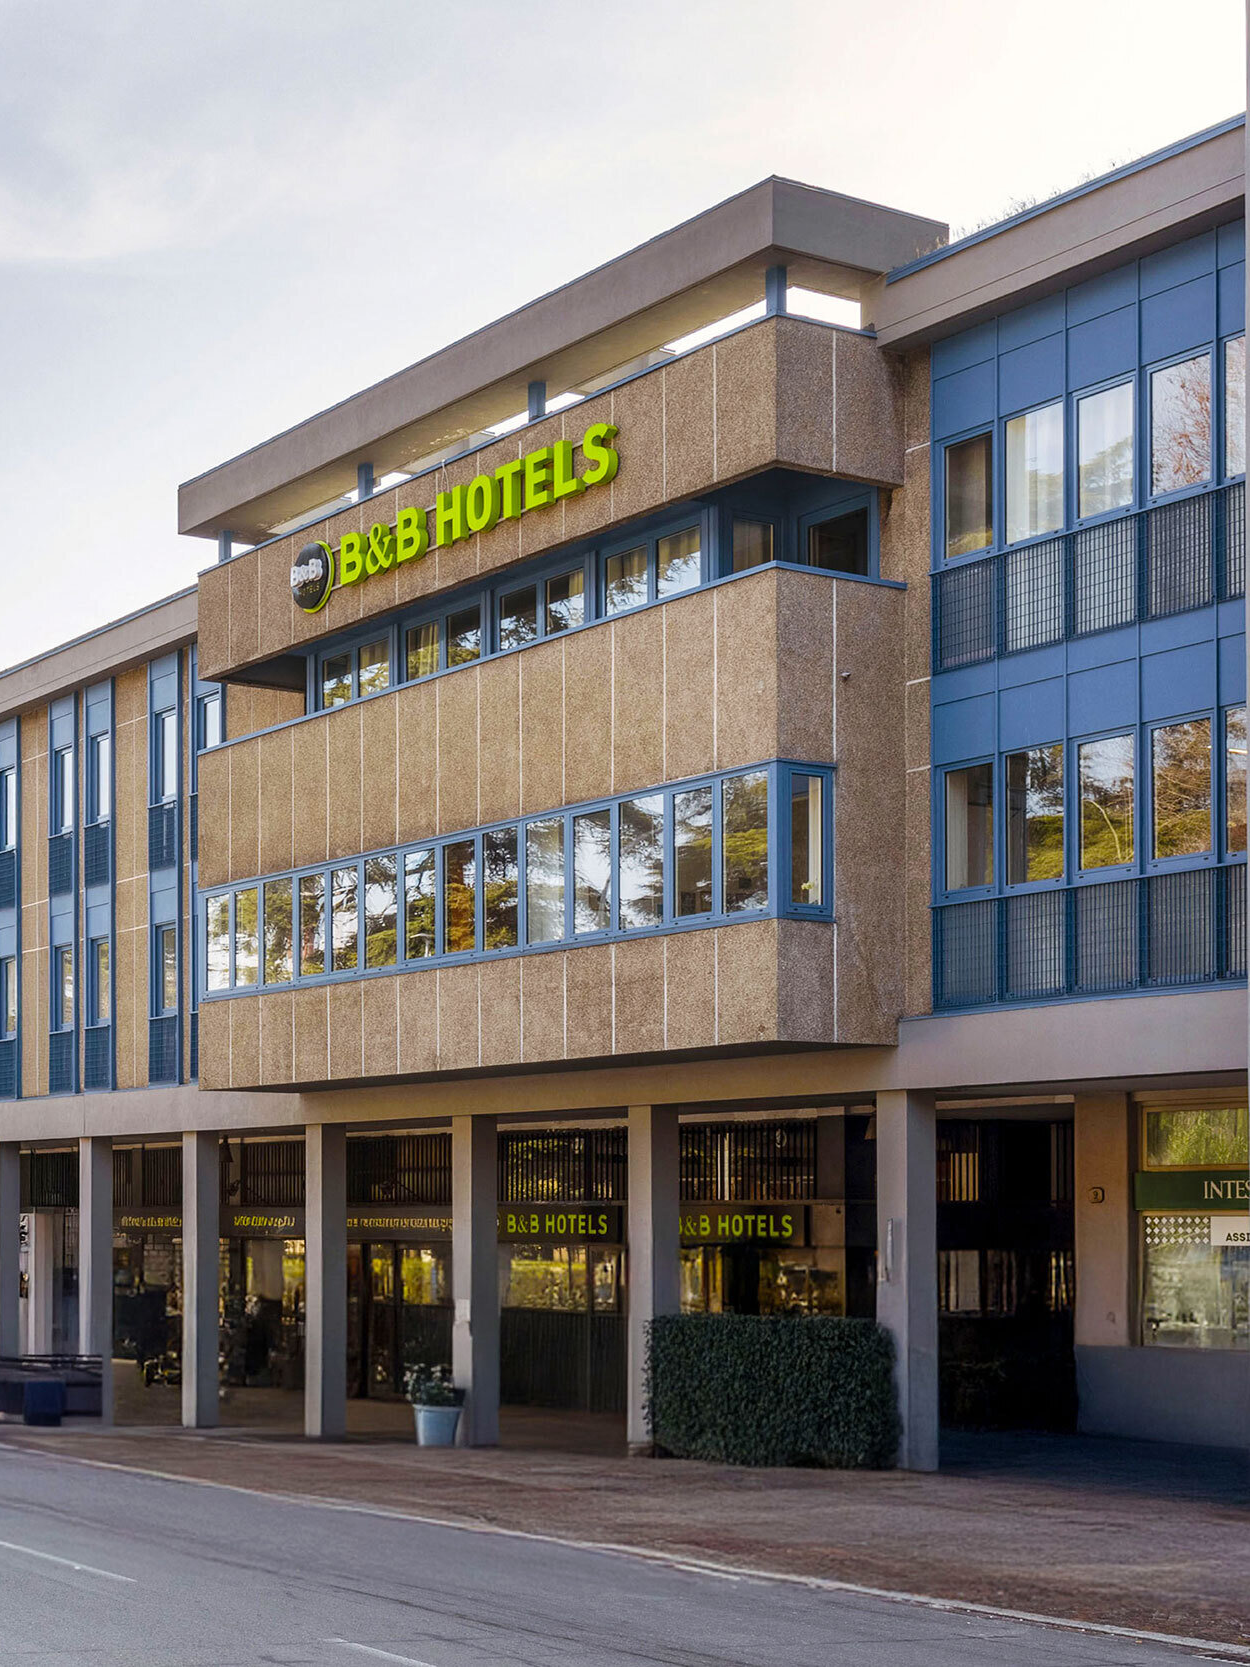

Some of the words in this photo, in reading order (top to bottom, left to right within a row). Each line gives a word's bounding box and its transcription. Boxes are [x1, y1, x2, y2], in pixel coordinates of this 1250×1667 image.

[340, 506, 430, 587] B&B
[436, 422, 620, 547] HOTELS
[290, 558, 323, 589] B&B
[507, 1214, 540, 1234] B&B
[545, 1214, 608, 1235] HOTELS
[717, 1214, 793, 1238] HOTELS
